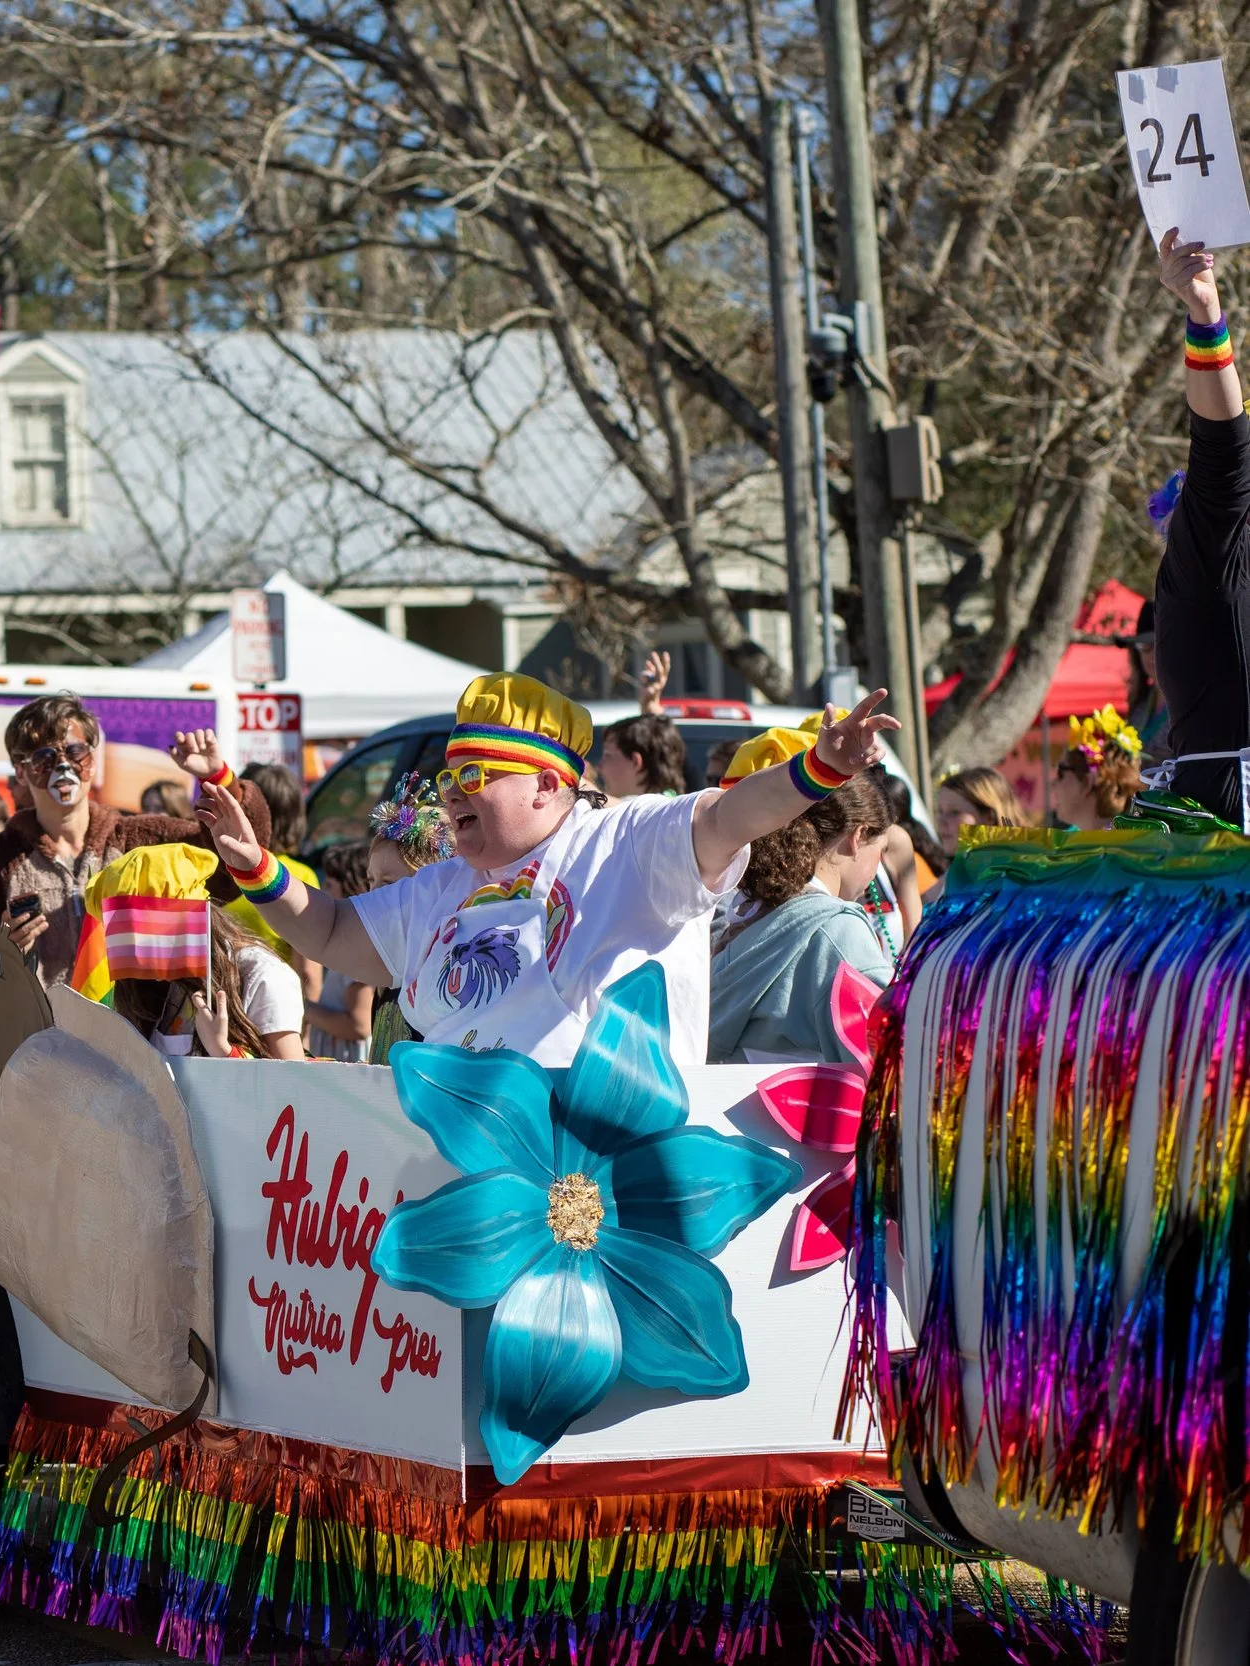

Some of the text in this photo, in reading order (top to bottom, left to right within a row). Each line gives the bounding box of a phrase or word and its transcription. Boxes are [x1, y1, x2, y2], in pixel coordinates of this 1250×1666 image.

[1136, 112, 1216, 184] 24
[238, 697, 298, 730] STOP
[849, 1514, 904, 1528] NELSON
